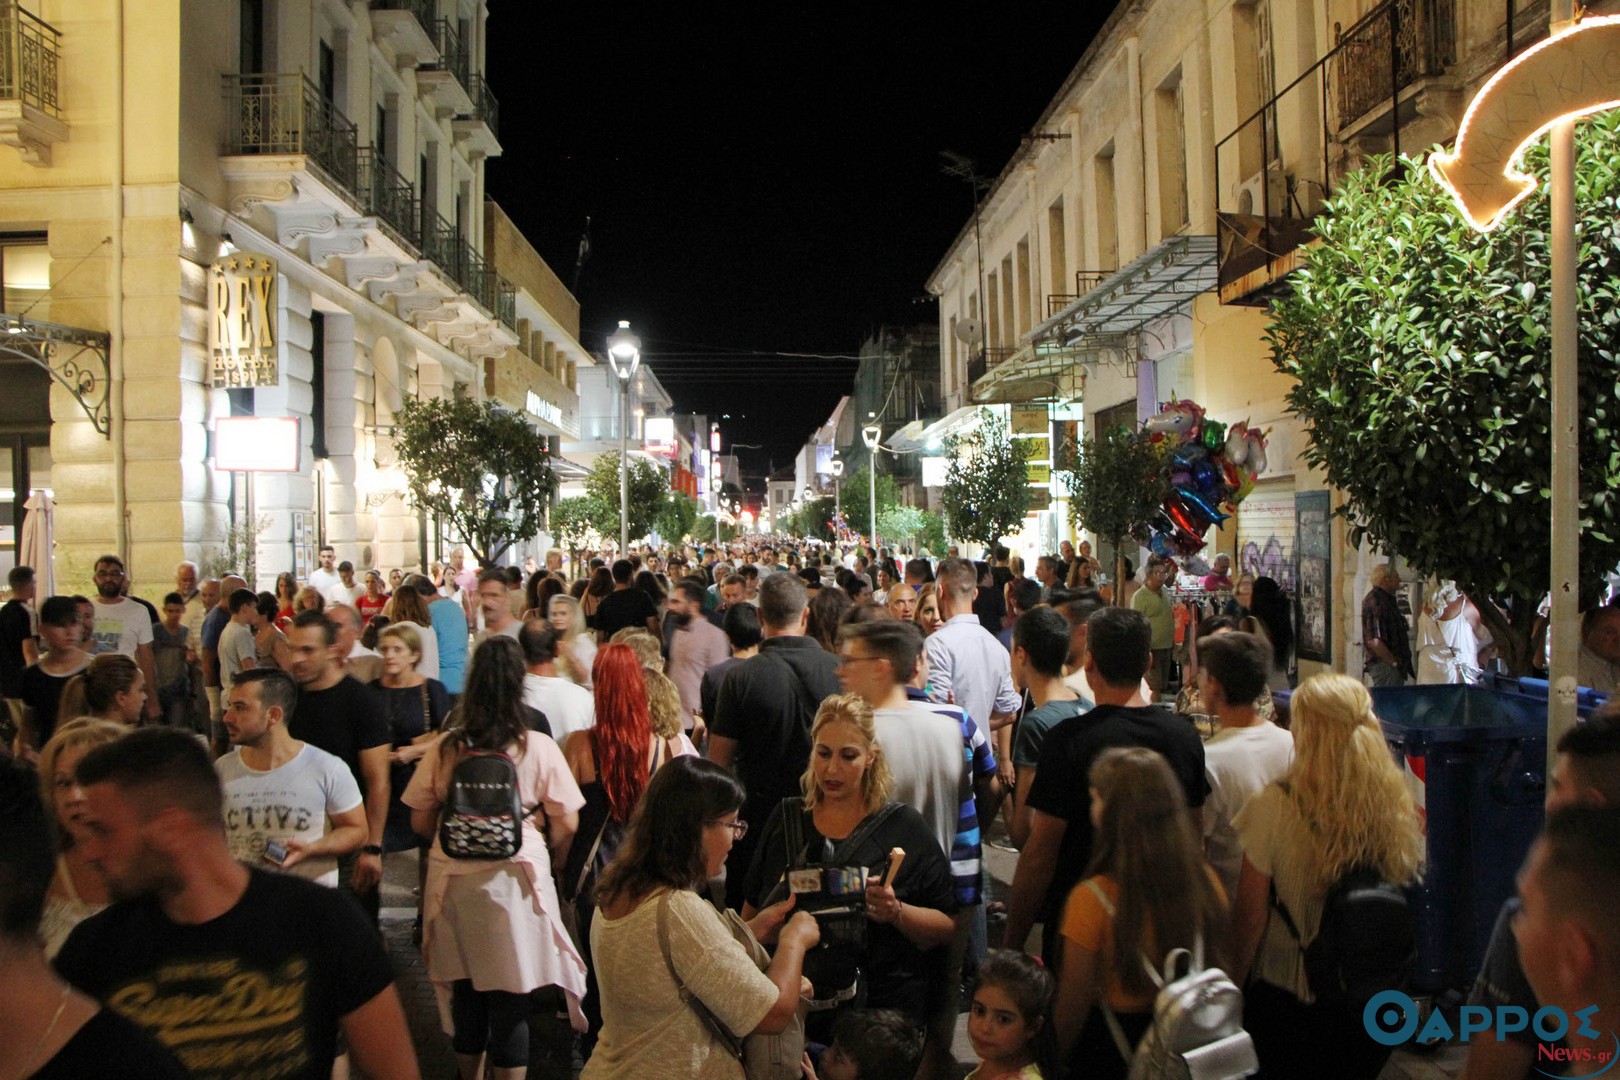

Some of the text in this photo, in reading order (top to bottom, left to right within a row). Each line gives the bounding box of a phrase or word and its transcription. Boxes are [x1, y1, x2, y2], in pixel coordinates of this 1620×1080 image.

[211, 276, 272, 349] REX
[212, 354, 273, 370] HOTEL
[227, 805, 311, 831] CTIVE
